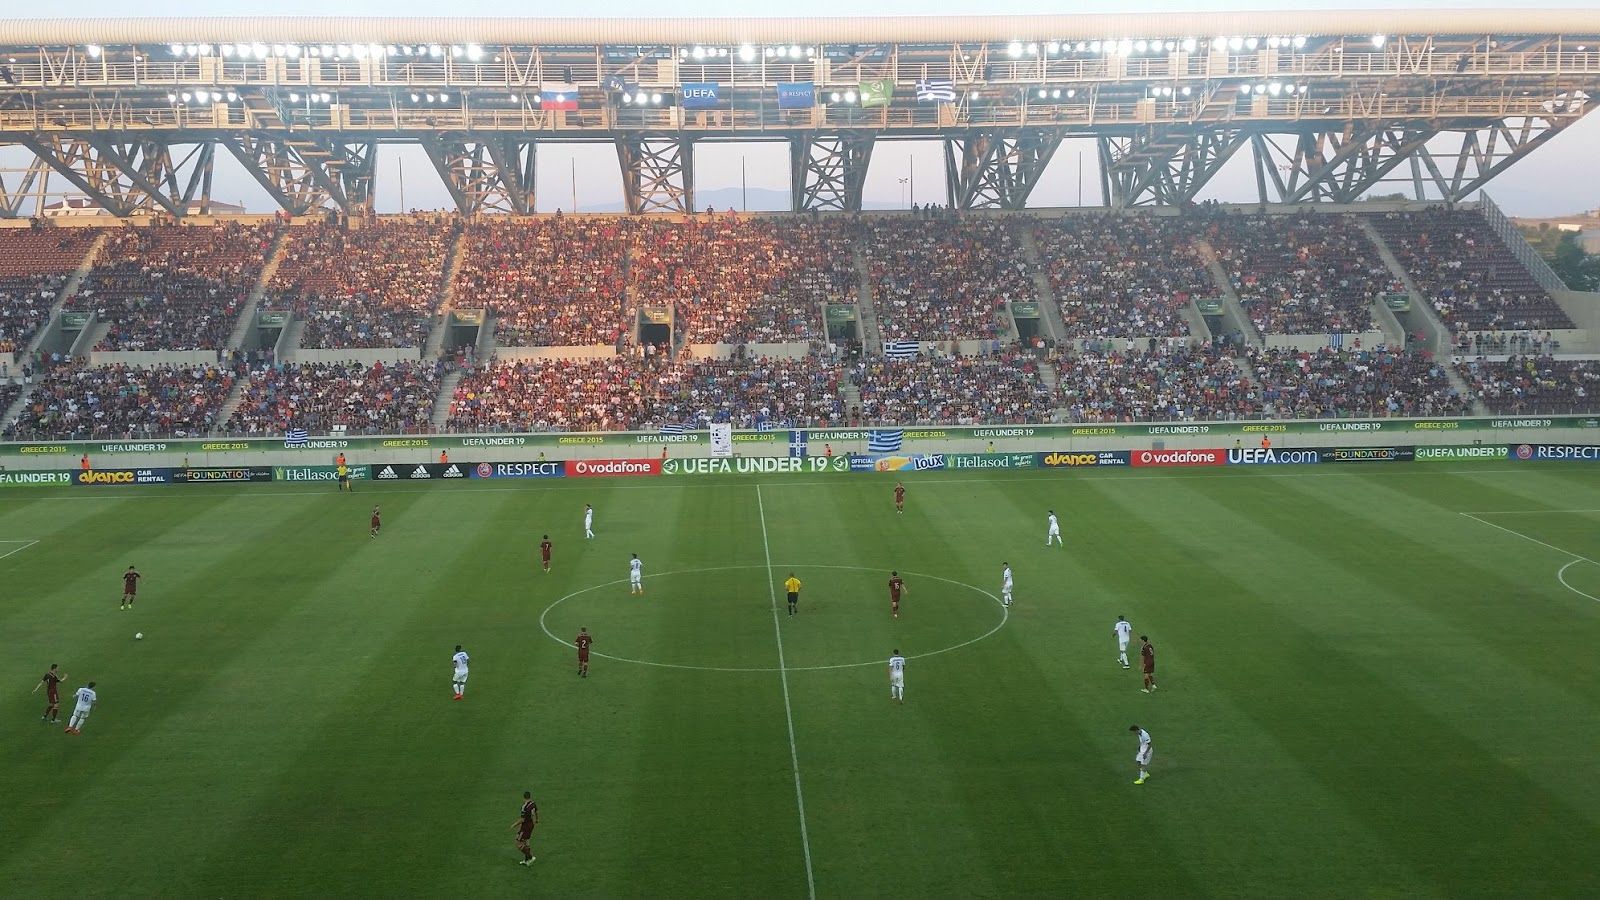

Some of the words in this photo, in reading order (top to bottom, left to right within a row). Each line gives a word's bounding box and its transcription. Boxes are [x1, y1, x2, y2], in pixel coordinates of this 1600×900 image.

[683, 89, 716, 99] UEFA
[1320, 423, 1342, 431] UEFA
[1342, 423, 1372, 431] UNDER
[1491, 420, 1513, 428] UEFA
[1513, 420, 1542, 428] UNDER
[973, 429, 995, 437] UEFA
[995, 429, 1023, 437] UNDER
[1148, 426, 1170, 434] UEFA
[1170, 426, 1199, 434] UNDER
[637, 435, 659, 443] UEFA
[659, 435, 688, 443] UNDER
[809, 432, 830, 440] UEFA
[830, 432, 859, 440] UNDER
[463, 438, 485, 446] UEFA
[485, 438, 515, 446] UNDER
[101, 443, 125, 452] UEFA
[125, 443, 156, 452] UNDER
[157, 443, 167, 451] 19
[1154, 451, 1216, 463] vodafone
[1228, 449, 1318, 464] UEFA.com
[1335, 450, 1395, 459] FOUNDATION
[1427, 448, 1455, 458] UEFA
[1458, 447, 1494, 457] UNDER
[1496, 447, 1508, 456] 19
[1537, 446, 1600, 459] RESPECT
[683, 458, 732, 473] UEFA
[737, 457, 802, 472] UNDER
[807, 457, 828, 472] 19
[956, 456, 1009, 468] Hellasod
[497, 463, 559, 476] RESPECT
[588, 461, 651, 473] vodafone
[15, 473, 56, 483] UNDER
[58, 472, 71, 482] 19
[187, 471, 250, 480] FOUNDATION
[581, 639, 587, 649] 2
[81, 693, 89, 702] 16
